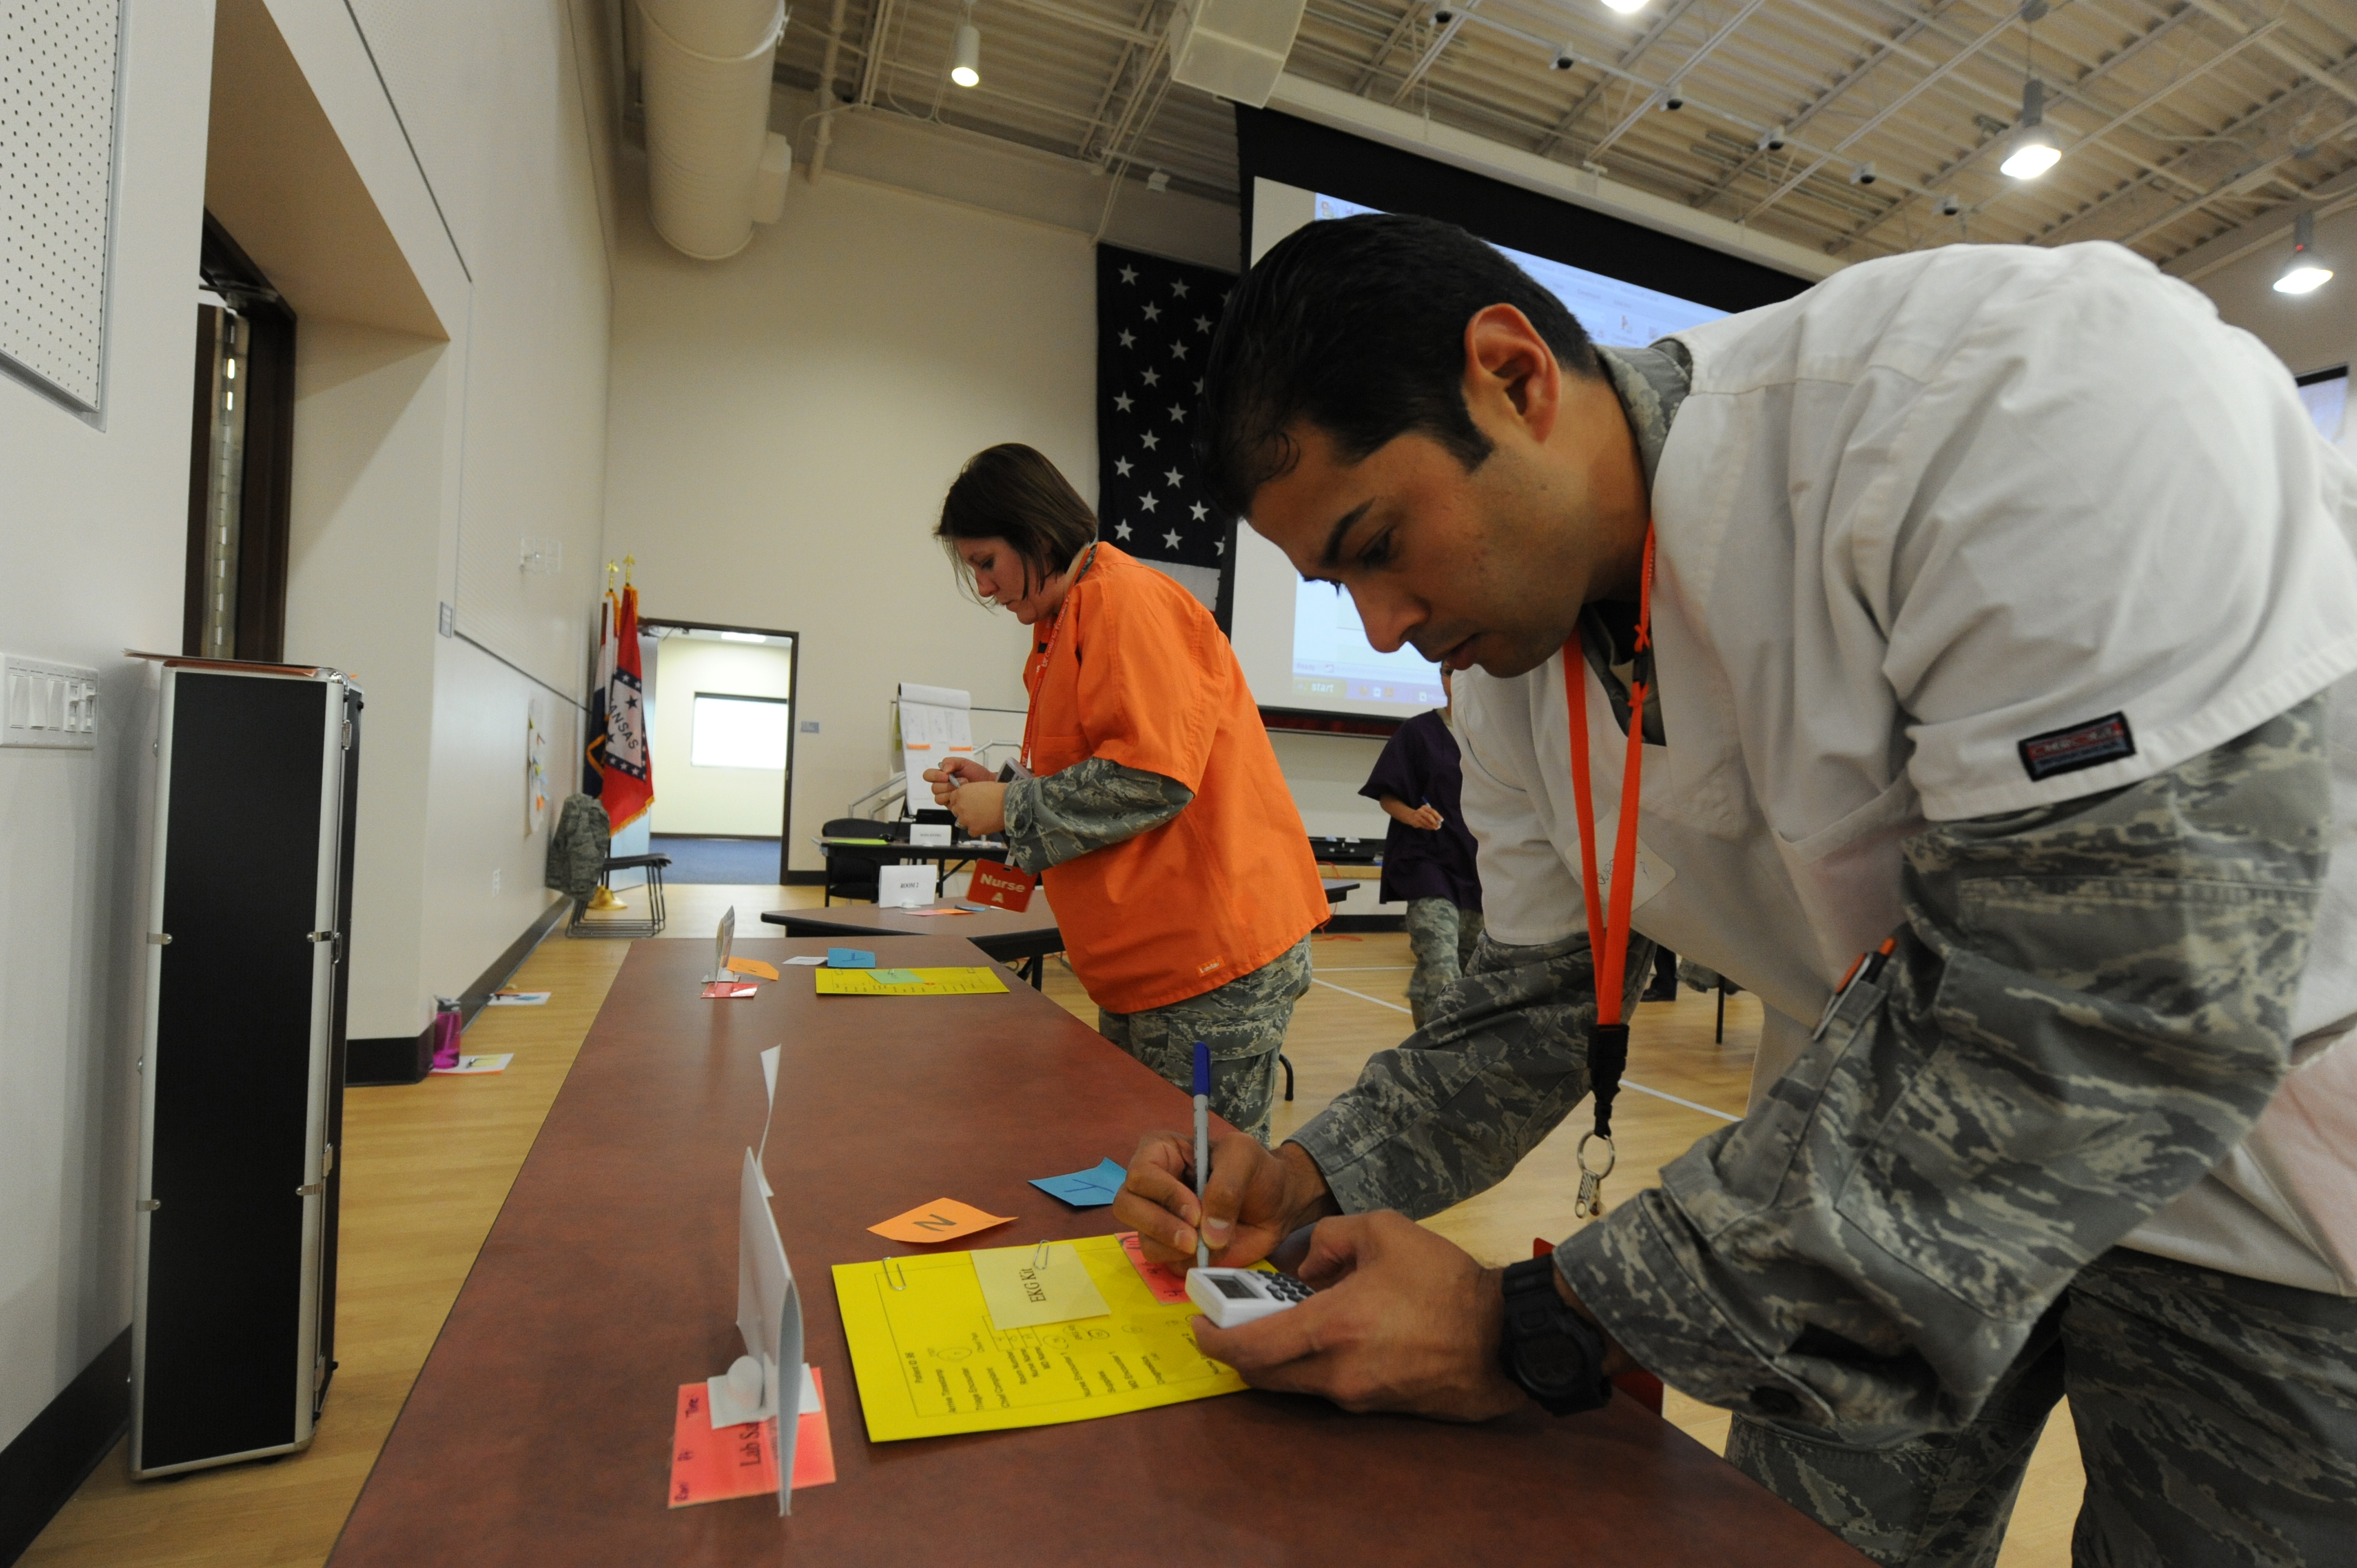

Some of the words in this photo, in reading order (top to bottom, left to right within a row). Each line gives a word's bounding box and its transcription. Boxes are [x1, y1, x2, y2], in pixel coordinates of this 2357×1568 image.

[1045, 639, 1055, 657] Center
[1055, 604, 1068, 630] Executive
[1311, 683, 1334, 693] start
[610, 699, 639, 749] ANSAS
[980, 873, 1026, 893] Nurse
[991, 892, 1004, 904] A
[1063, 1179, 1115, 1194] Y
[1018, 1268, 1036, 1281] Kit
[1024, 1282, 1046, 1302] EKG
[1006, 1350, 1020, 1370] Number
[1021, 1348, 1031, 1363] Name
[1035, 1346, 1046, 1361] Name
[1028, 1363, 1039, 1378] Nurse
[1040, 1361, 1051, 1370] MD
[1064, 1356, 1082, 1381] Encounter
[1113, 1355, 1133, 1380] Encounter
[935, 1369, 949, 1396] Timestamp
[962, 1366, 977, 1394] Encounter
[986, 1367, 1003, 1394] Complaint
[1016, 1369, 1027, 1385] Room
[1079, 1381, 1092, 1397] Nurse
[739, 1442, 761, 1467] Lab
